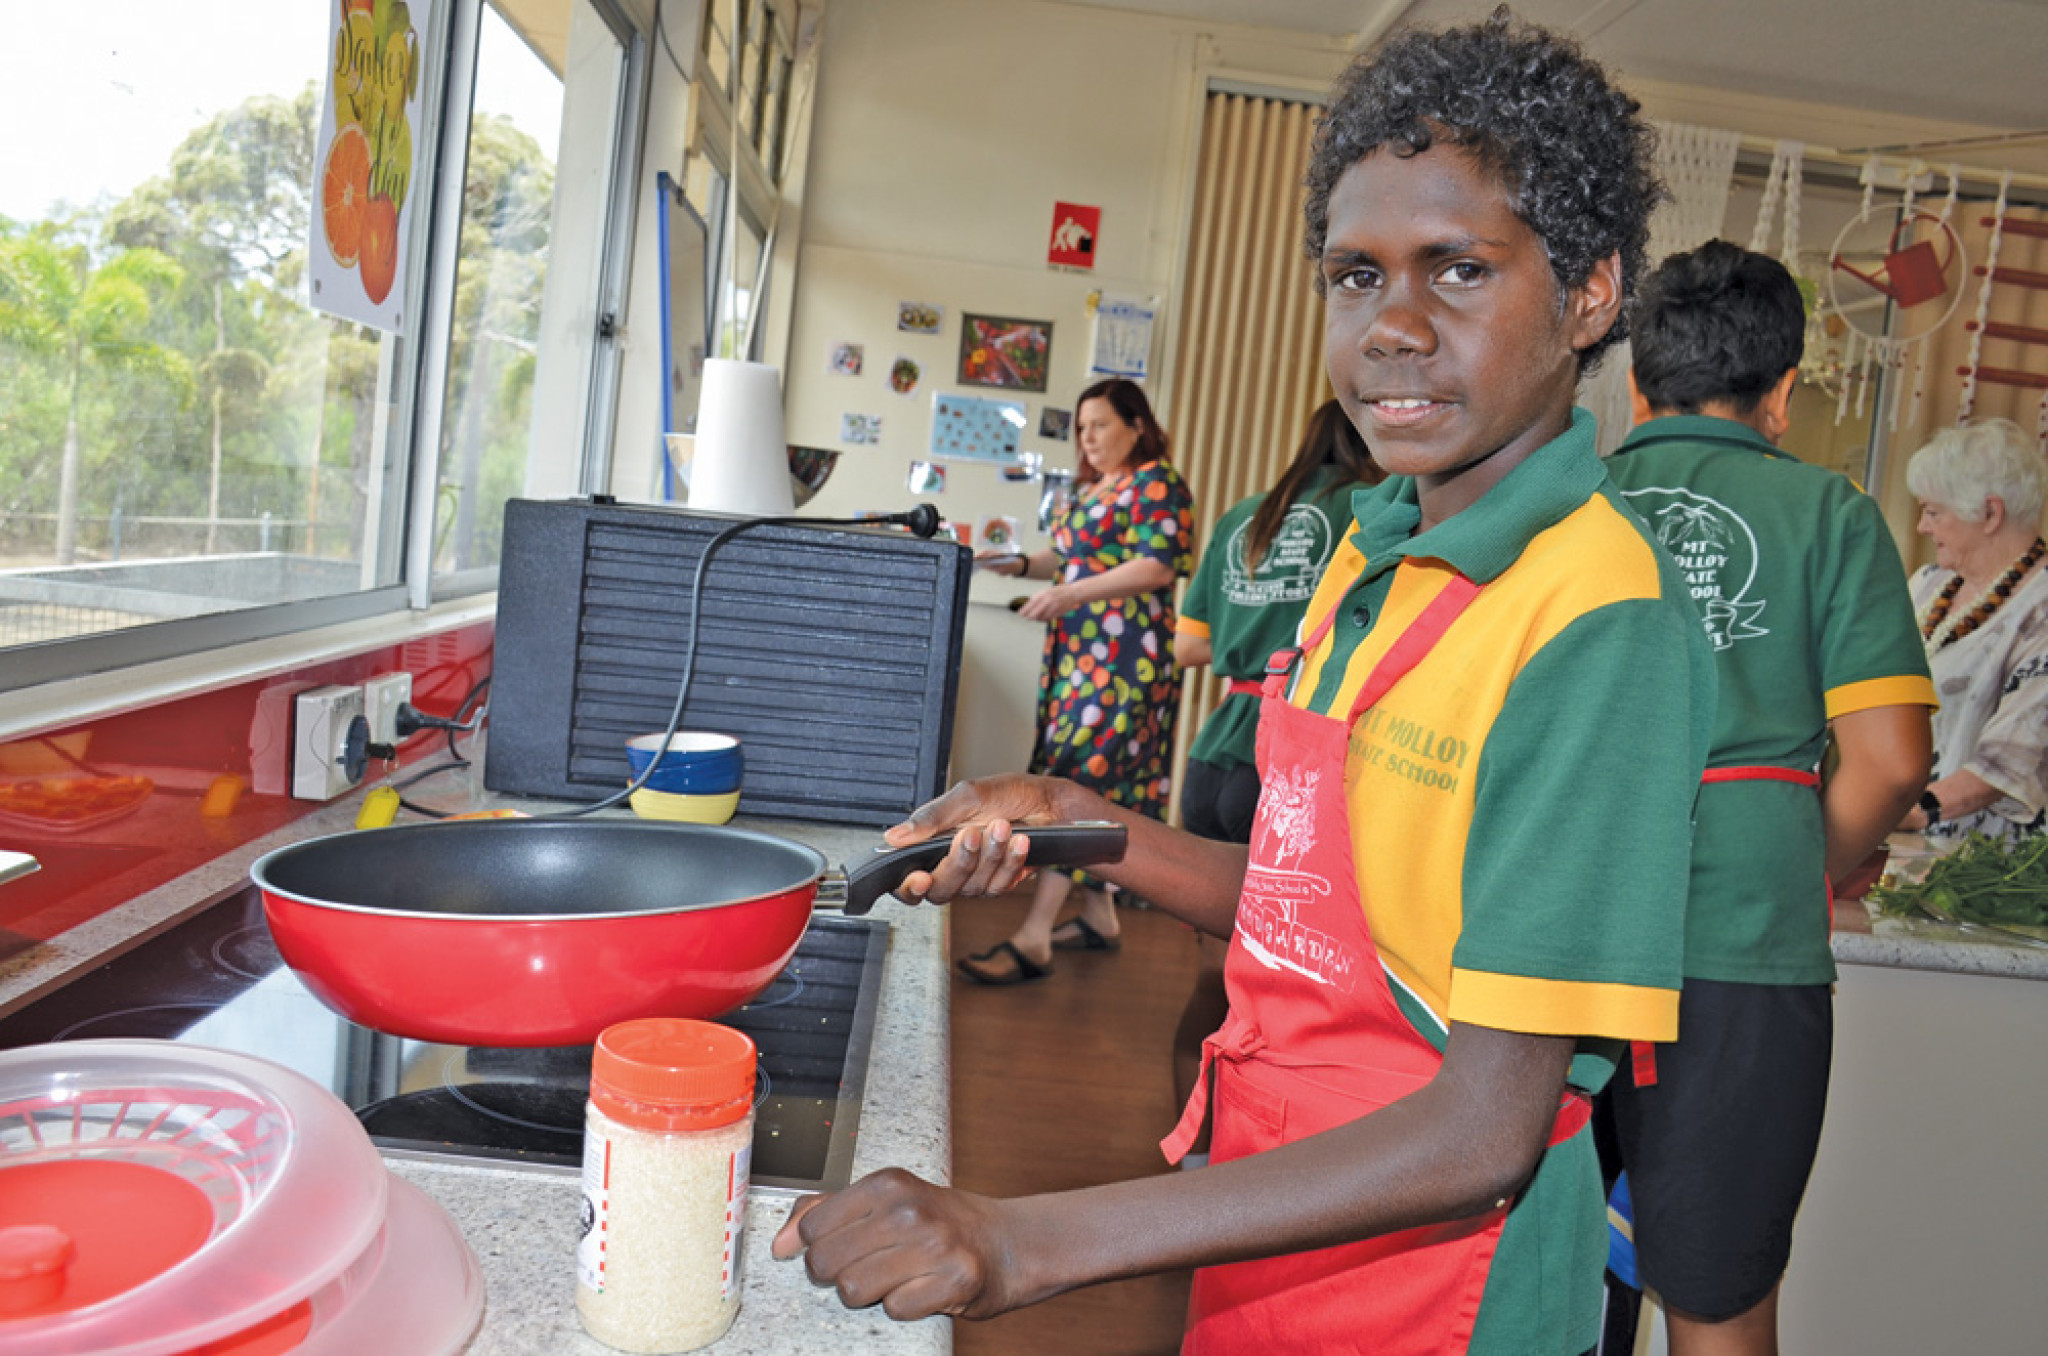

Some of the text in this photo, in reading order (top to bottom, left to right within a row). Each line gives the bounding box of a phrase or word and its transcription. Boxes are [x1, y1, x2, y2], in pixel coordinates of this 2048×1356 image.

[1681, 541, 1707, 553] MT
[1674, 554, 1729, 568] OLLOY
[1682, 569, 1717, 584] ATE
[1689, 585, 1723, 600] OOL
